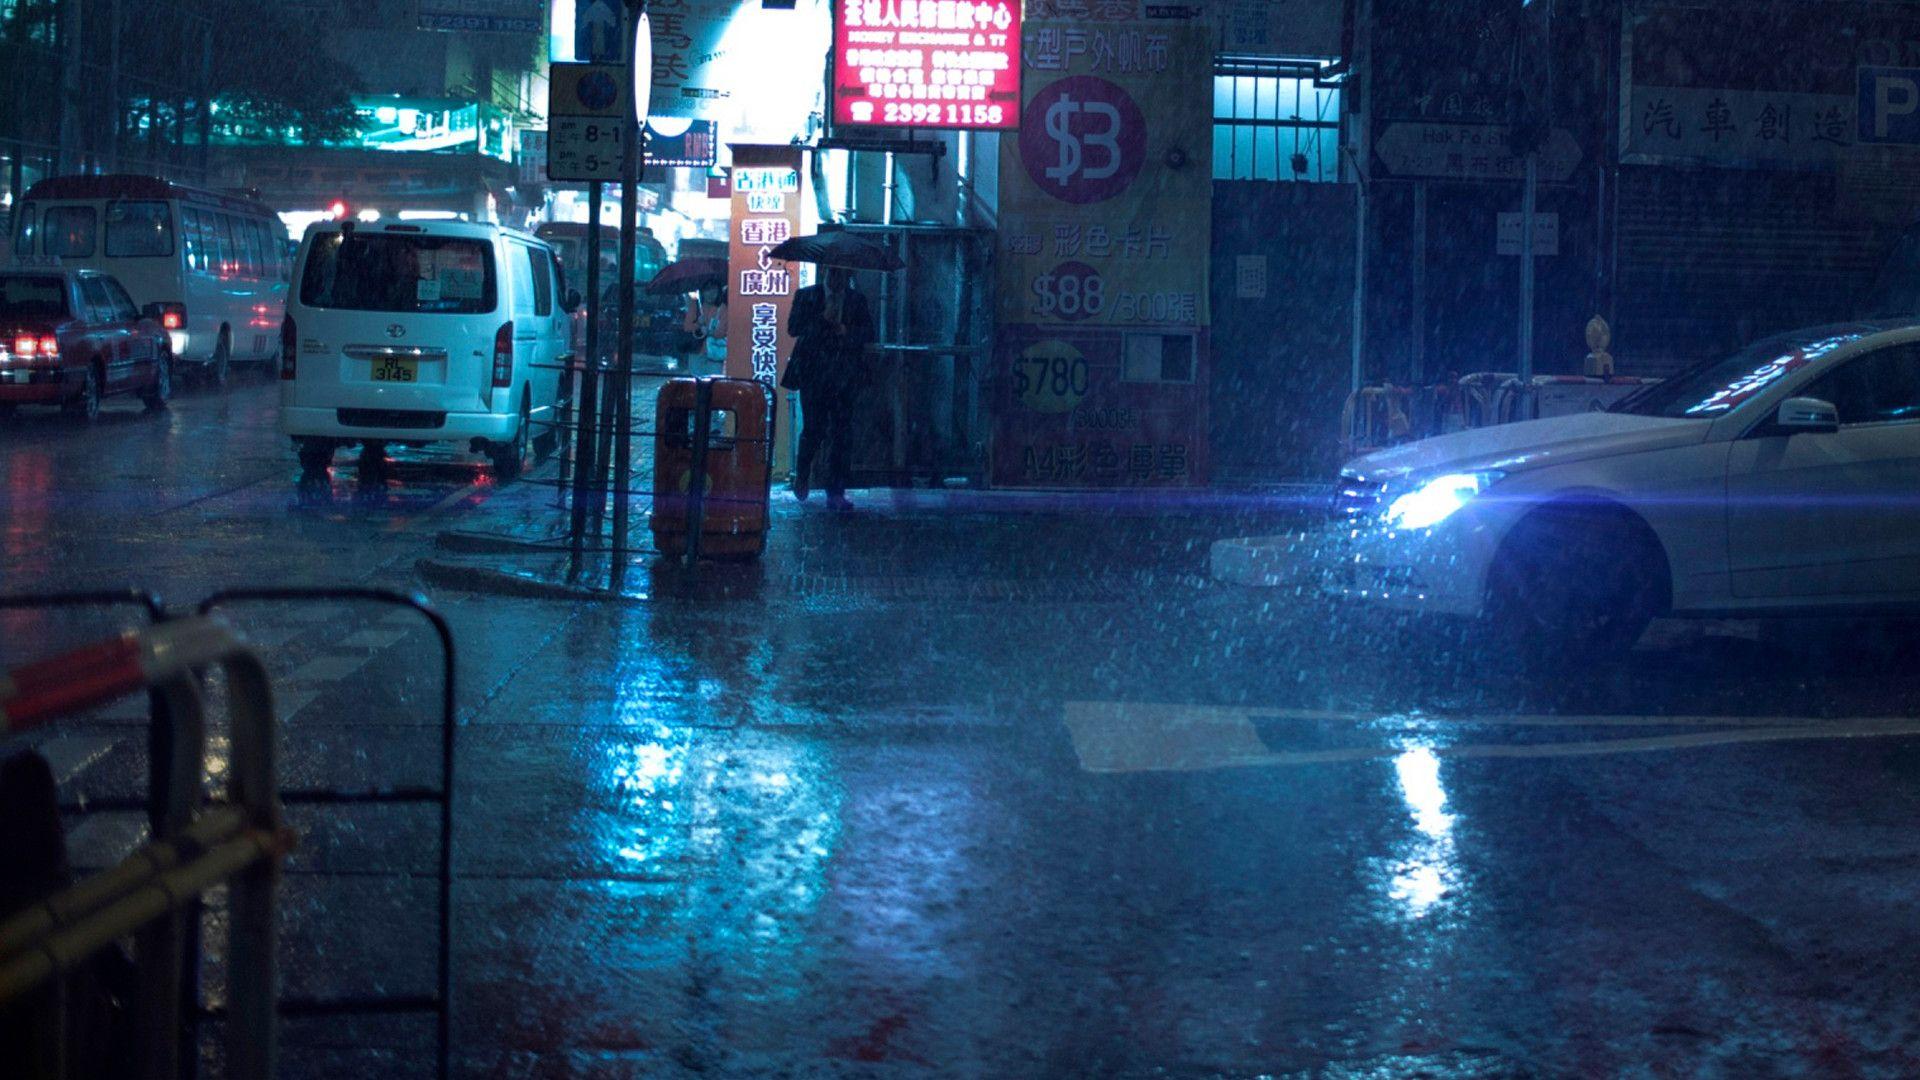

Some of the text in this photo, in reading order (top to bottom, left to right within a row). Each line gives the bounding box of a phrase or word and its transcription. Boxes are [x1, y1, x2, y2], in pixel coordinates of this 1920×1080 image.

[884, 102, 1003, 124] 2392 1158
[1874, 76, 1919, 138] P
[744, 220, 788, 242] 香港
[743, 272, 788, 293] 廣州
[1032, 270, 1105, 318] $88
[376, 369, 412, 381] 3145
[1010, 355, 1090, 398] $780
